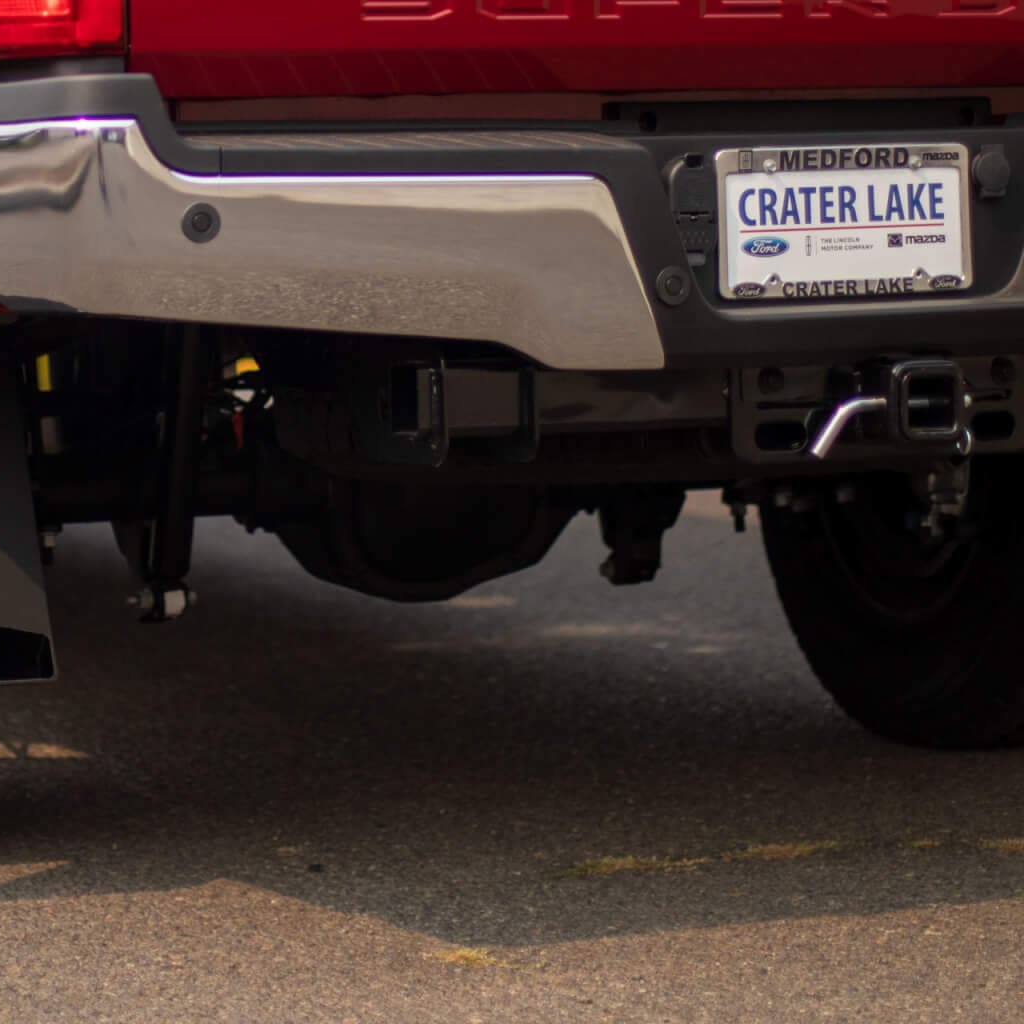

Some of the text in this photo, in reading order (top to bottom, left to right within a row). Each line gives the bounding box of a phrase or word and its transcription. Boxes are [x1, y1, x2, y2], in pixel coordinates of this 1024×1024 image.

[779, 147, 910, 171] MEDFORD
[738, 183, 945, 227] CRATER LAKE
[905, 233, 946, 245] mazda
[782, 276, 914, 298] CRATER LAKE
